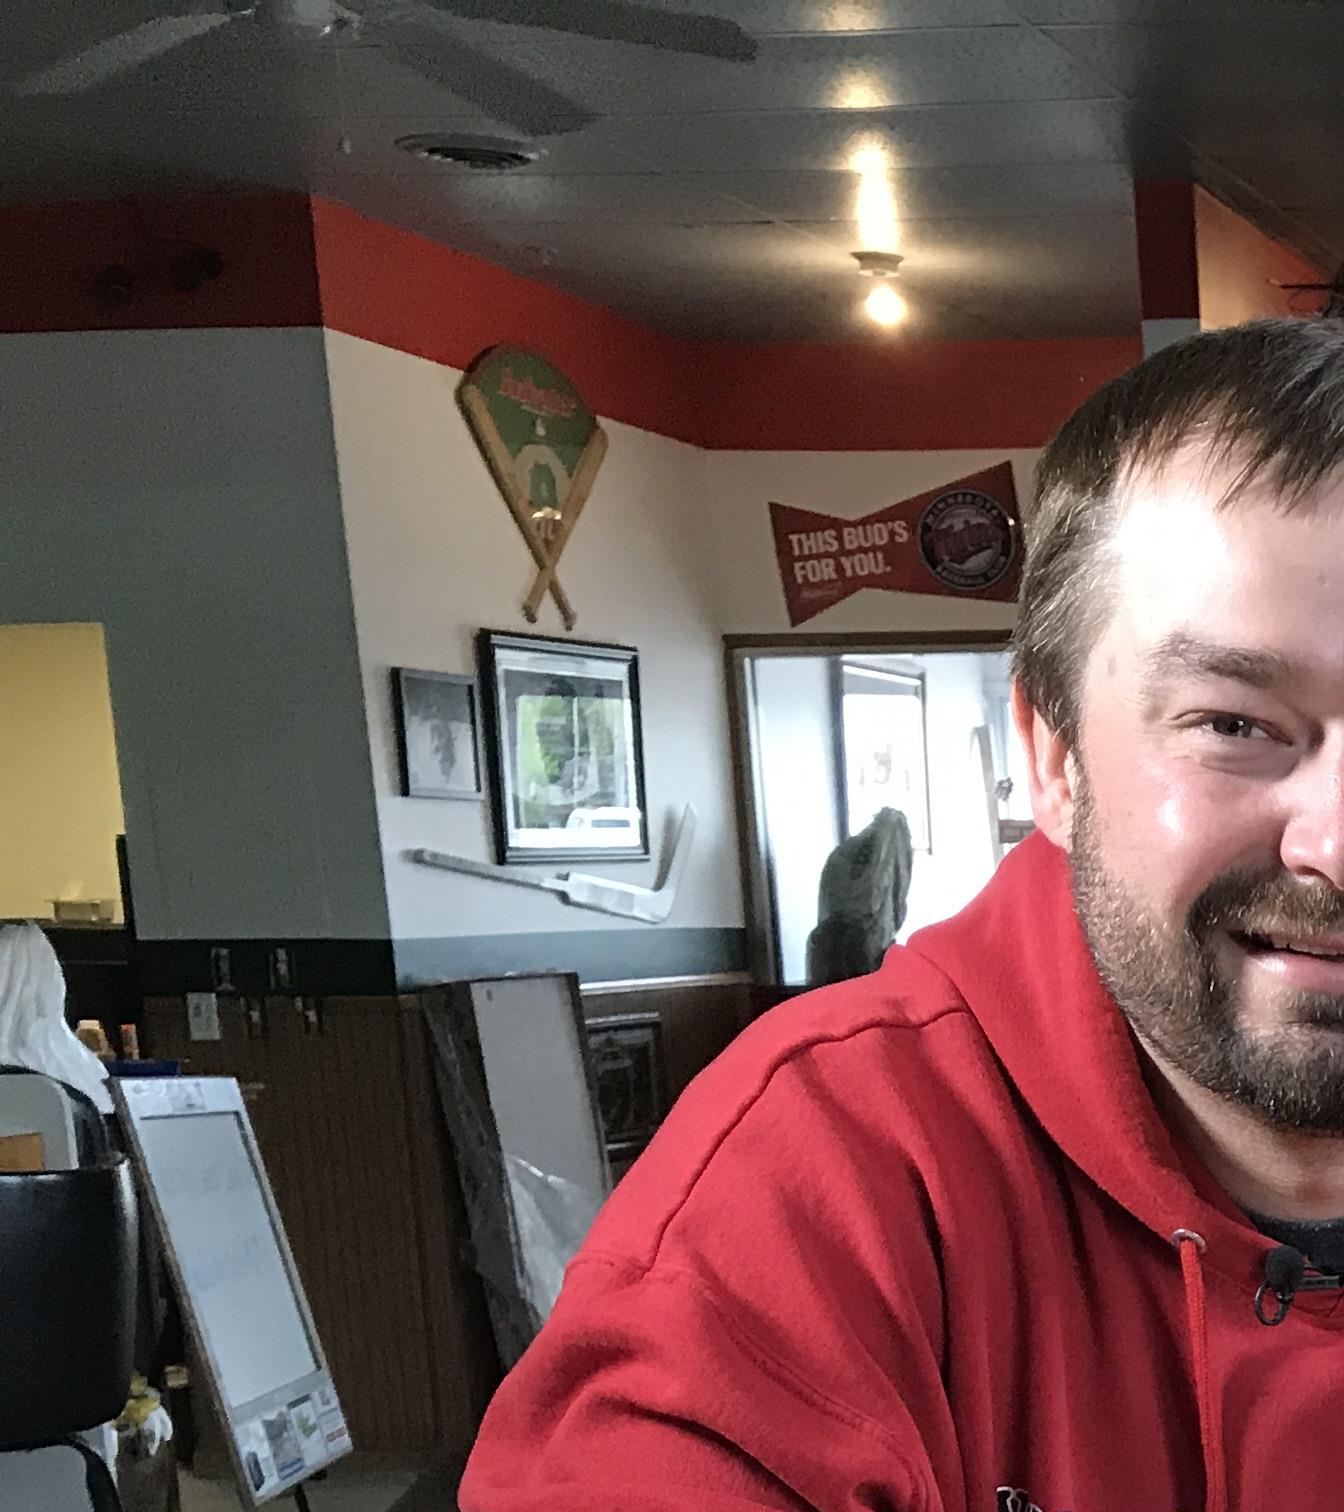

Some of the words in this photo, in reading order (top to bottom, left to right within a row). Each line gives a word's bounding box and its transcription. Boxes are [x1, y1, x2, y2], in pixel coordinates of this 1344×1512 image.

[788, 530, 839, 557] THIS
[842, 520, 909, 550] BUD'S
[793, 558, 838, 584] FOR
[841, 551, 892, 578] YOU.
